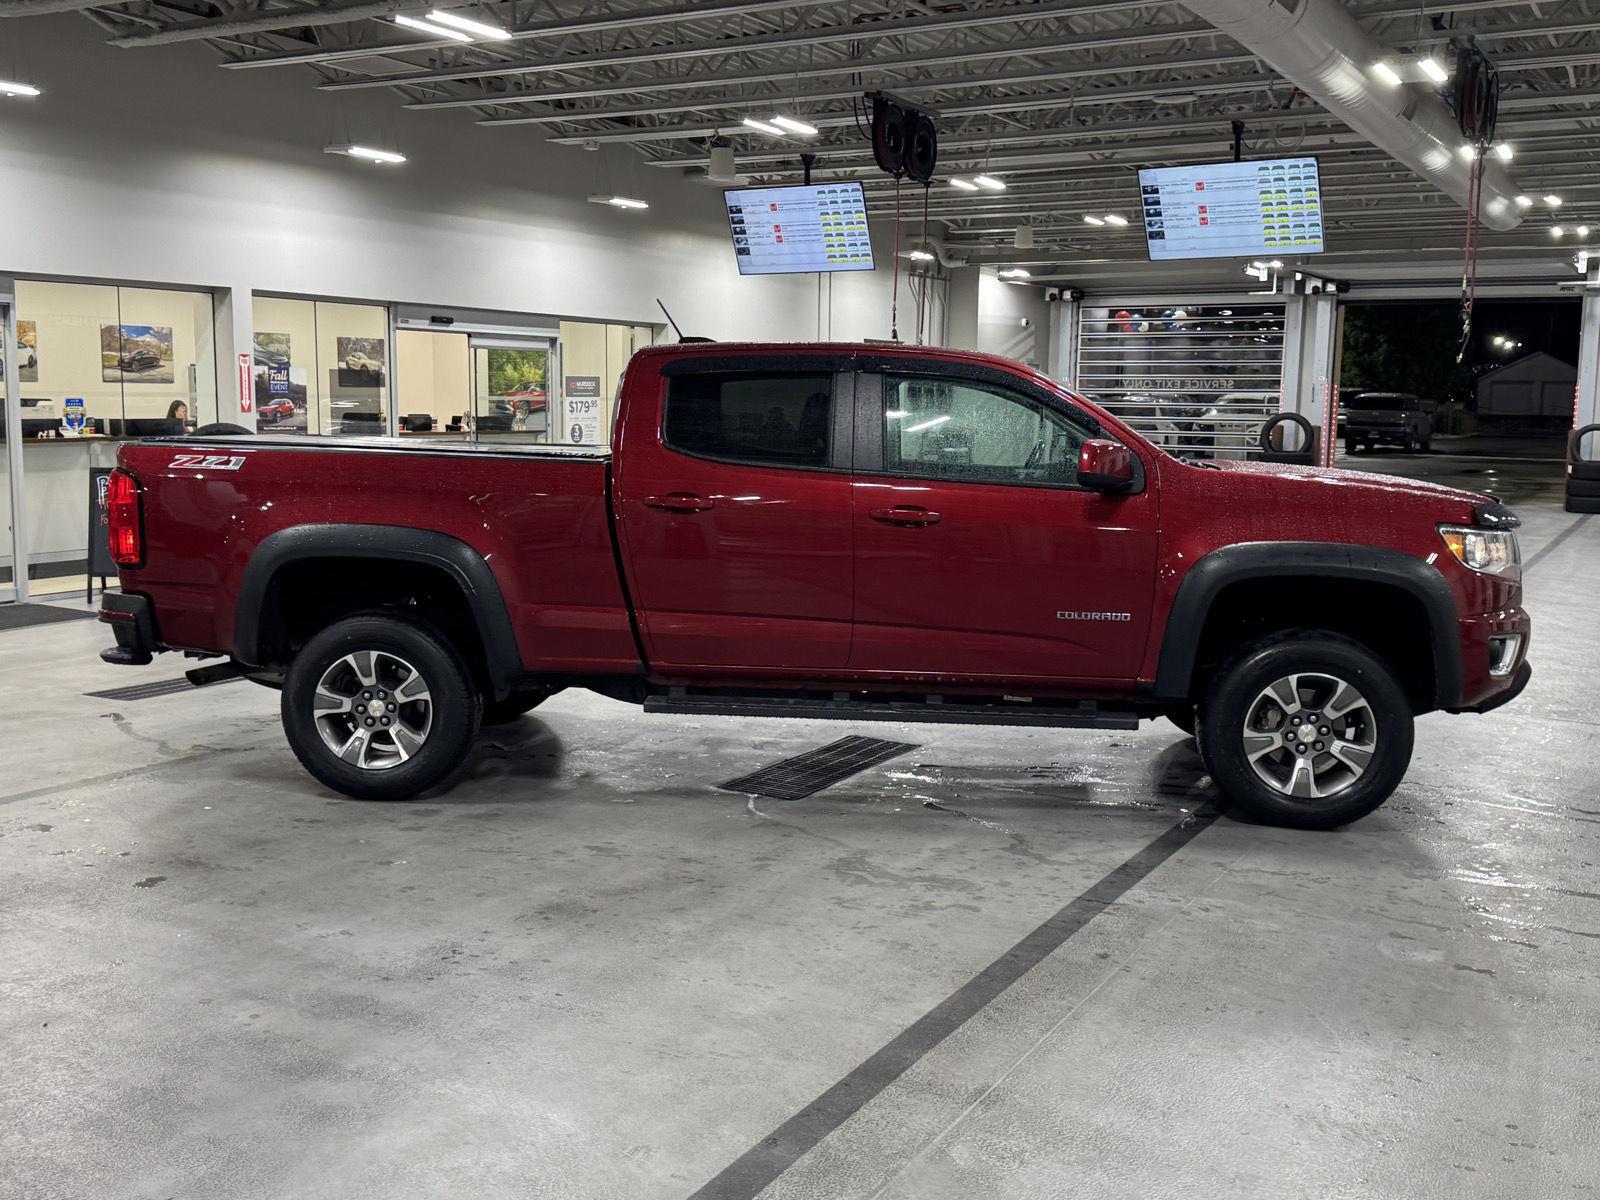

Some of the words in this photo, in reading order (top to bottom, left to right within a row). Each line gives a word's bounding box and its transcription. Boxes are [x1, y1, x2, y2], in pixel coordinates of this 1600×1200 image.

[269, 369, 288, 380] Fall
[167, 454, 247, 470] Z71
[1056, 611, 1131, 621] COLORADO
